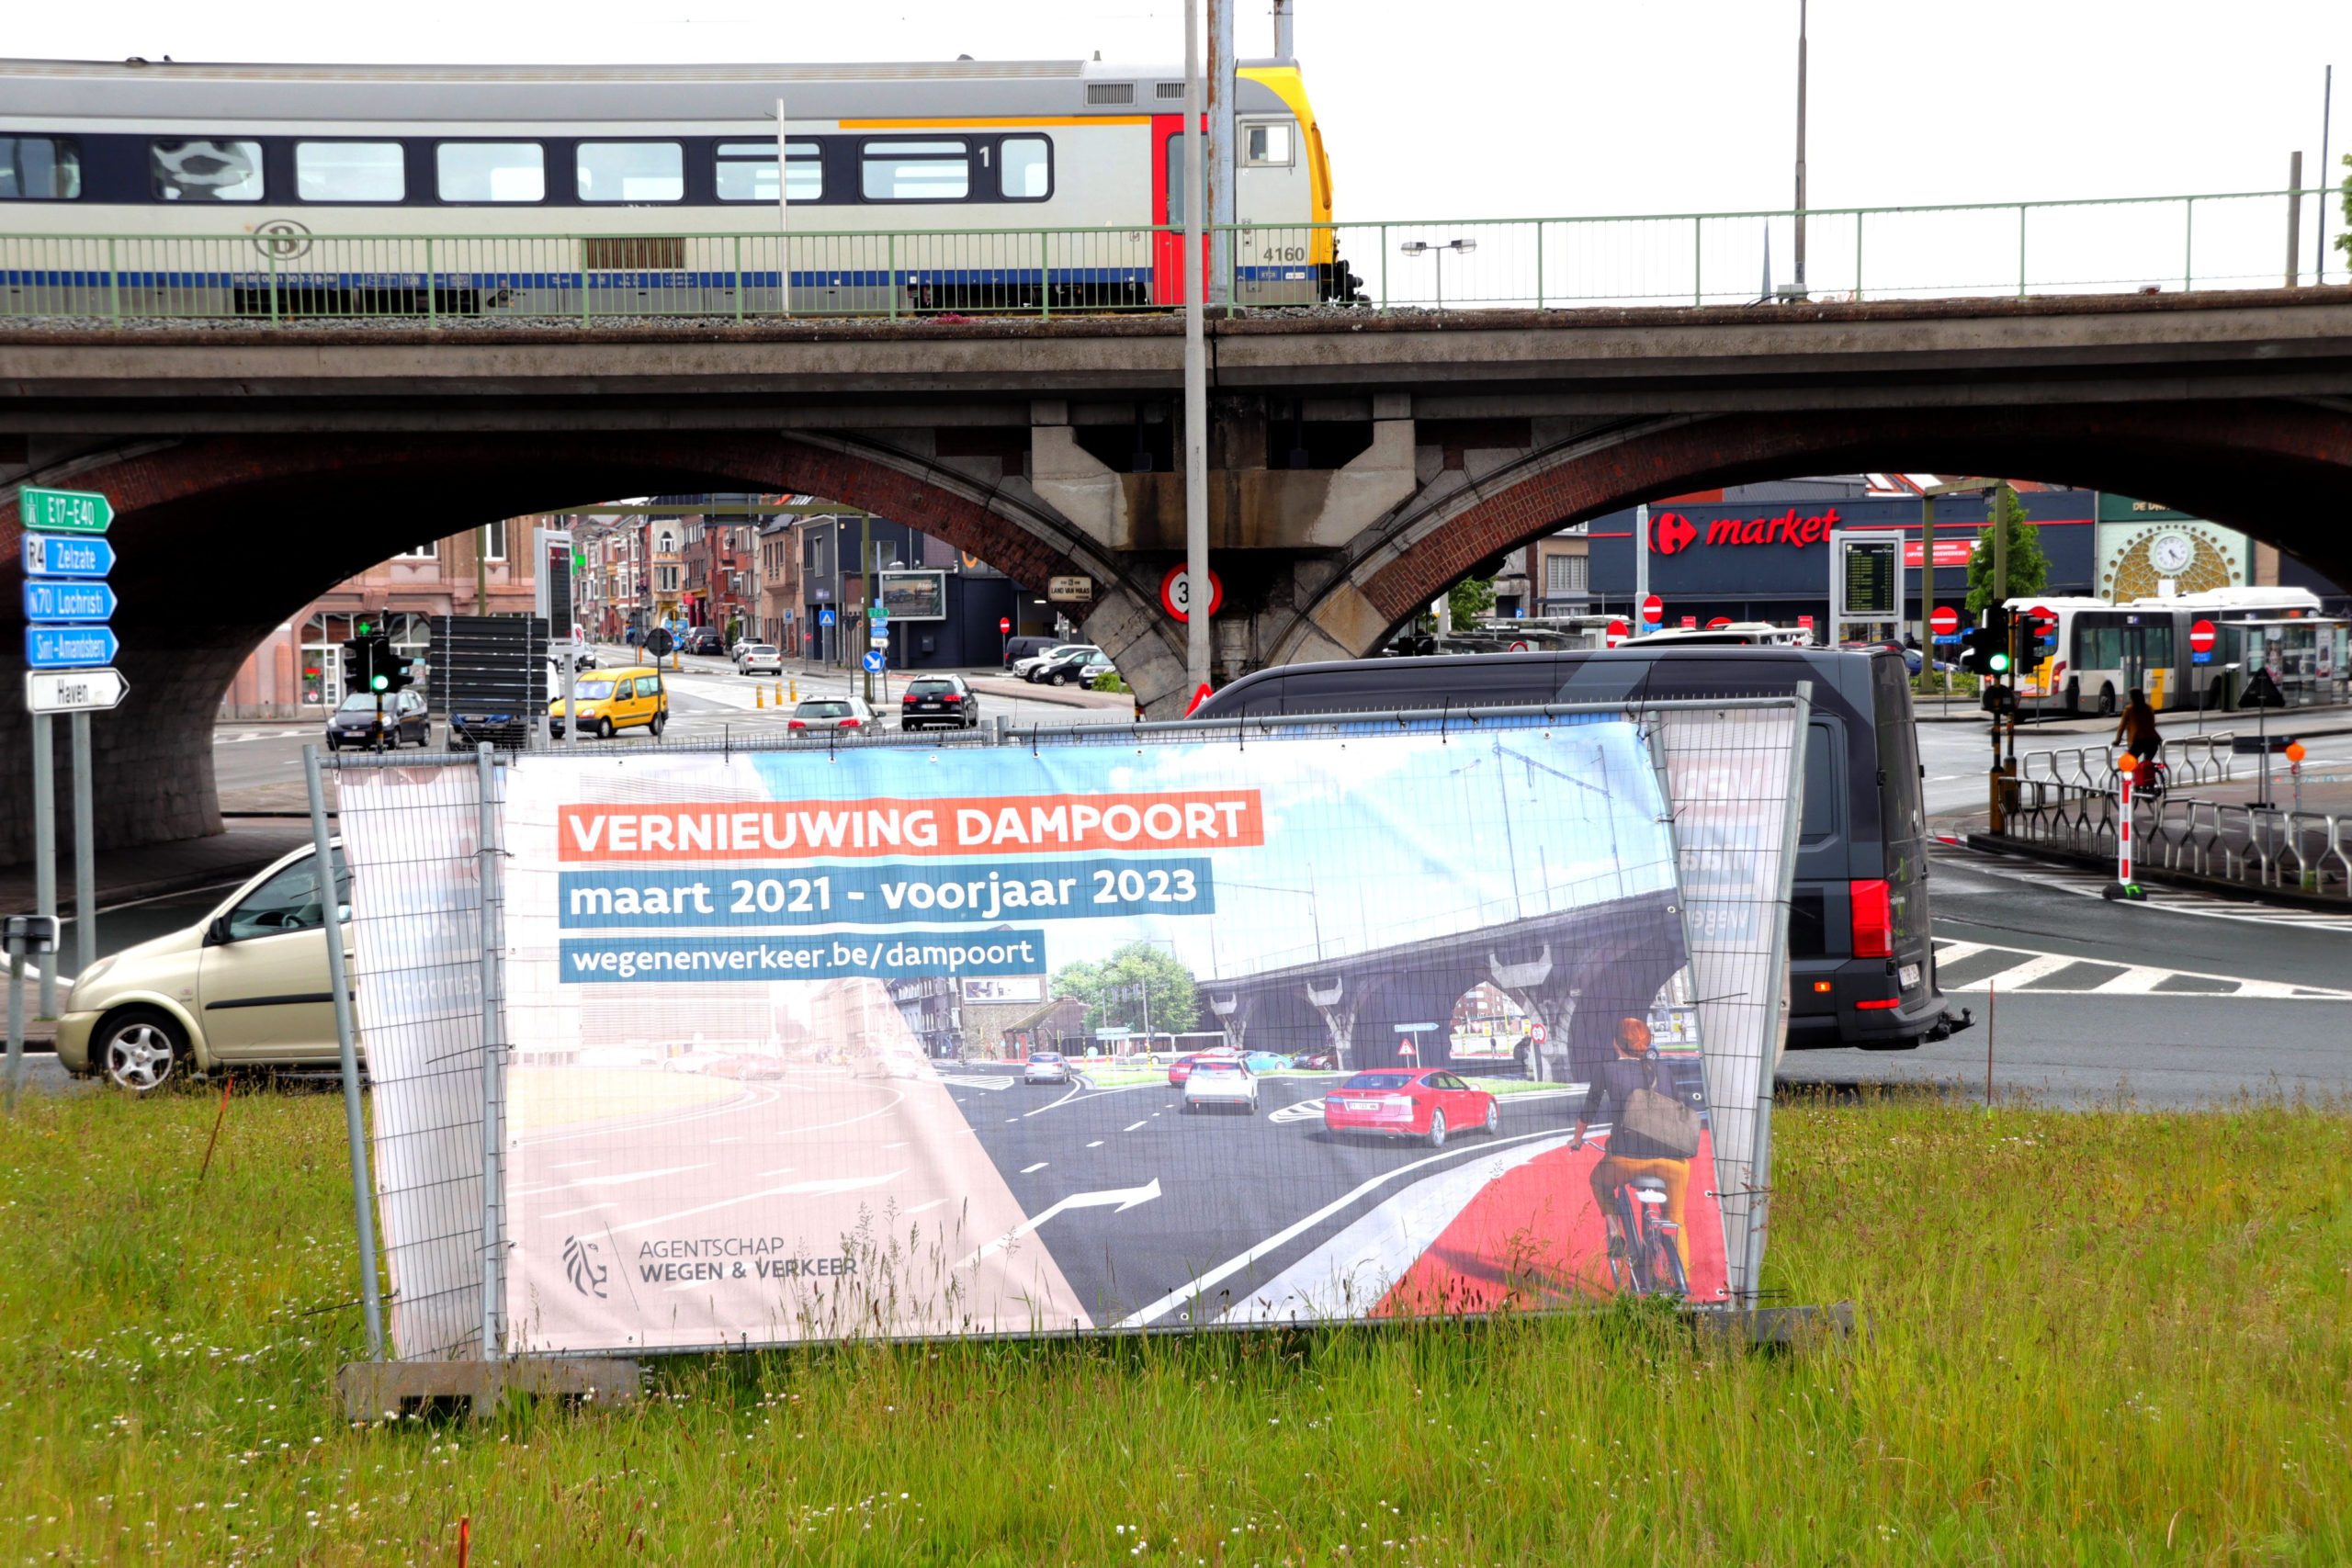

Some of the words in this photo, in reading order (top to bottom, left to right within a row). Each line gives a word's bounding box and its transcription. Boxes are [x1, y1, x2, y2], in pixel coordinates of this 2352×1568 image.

[978, 146, 989, 167] 1
[1263, 247, 1305, 262] 4160
[48, 497, 95, 525] E17-E40
[1706, 508, 1841, 547] market
[29, 542, 44, 568] R4
[57, 543, 96, 570] Zelzate
[30, 588, 52, 614] N70
[58, 588, 104, 614] Lochristi
[57, 679, 88, 704] Haven
[569, 808, 938, 852] VERNIEUWING
[956, 801, 1246, 846] DAMPOORT
[570, 881, 714, 916] maart
[730, 876, 830, 914] 2021
[847, 890, 865, 900] -
[880, 871, 1077, 919] voorjaar
[1093, 868, 1196, 904] 2023
[572, 940, 1035, 978] wegenenverkeer.be/dampoort
[639, 1236, 785, 1258] AGENTSCHAP
[639, 1262, 723, 1283] WEGEN
[731, 1262, 747, 1279] &
[755, 1258, 858, 1279] VERKEER
